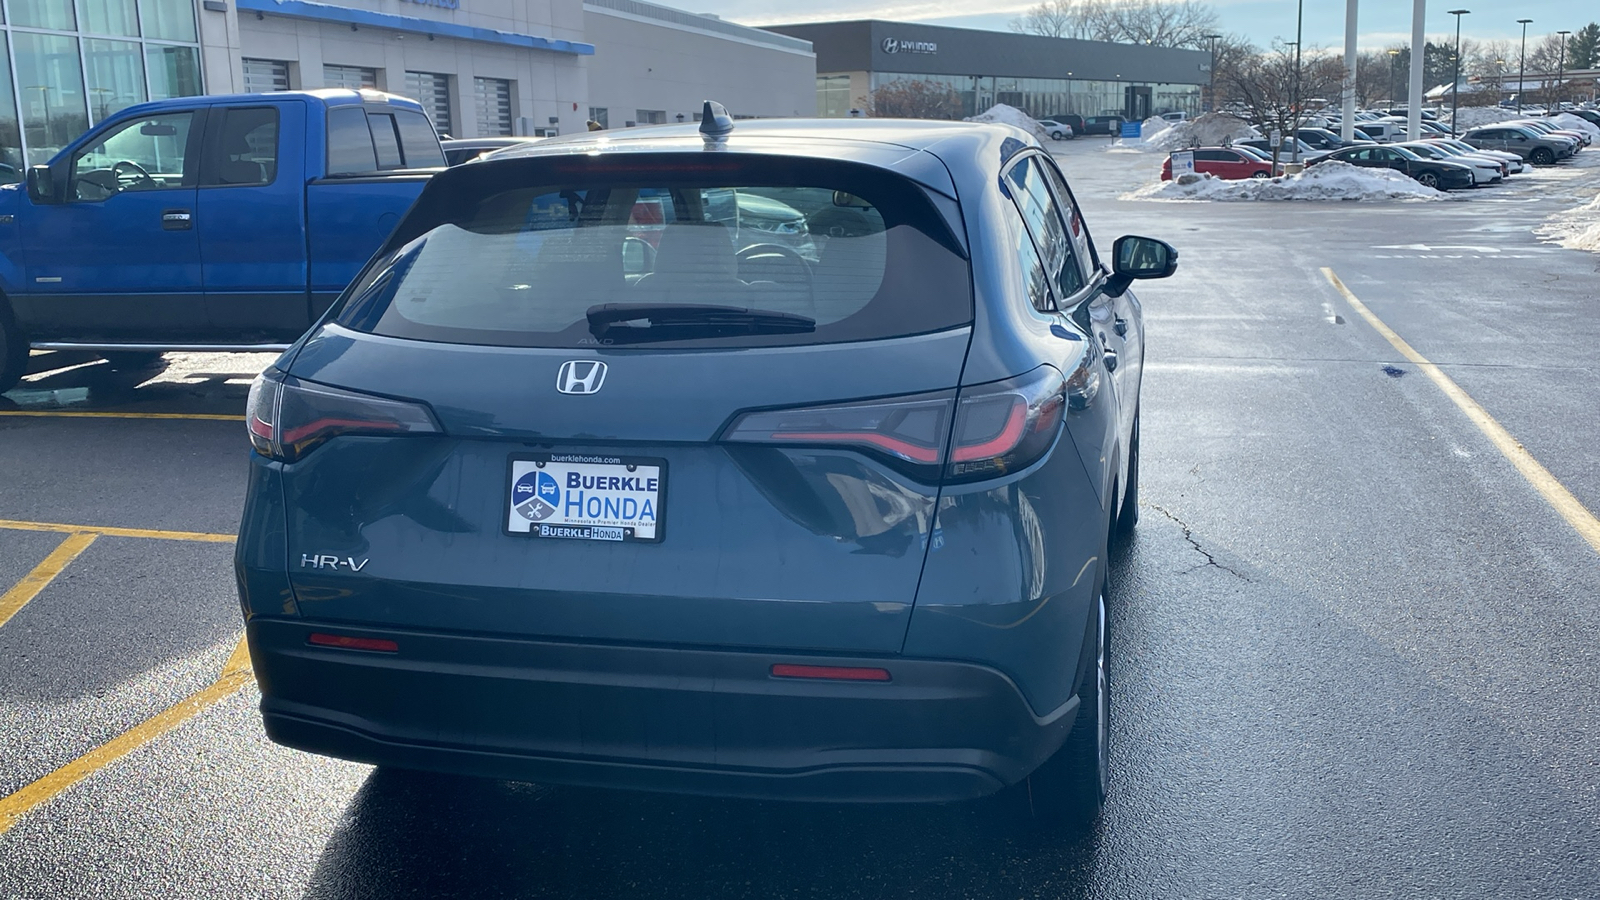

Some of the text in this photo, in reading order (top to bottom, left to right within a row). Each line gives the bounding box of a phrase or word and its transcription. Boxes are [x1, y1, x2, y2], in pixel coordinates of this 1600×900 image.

[900, 40, 937, 51] HYUNDAI
[551, 454, 621, 464] buerklehonda.com
[566, 471, 658, 492] BUERKLE
[564, 490, 656, 521] HONDA
[301, 553, 369, 572] HR-V
